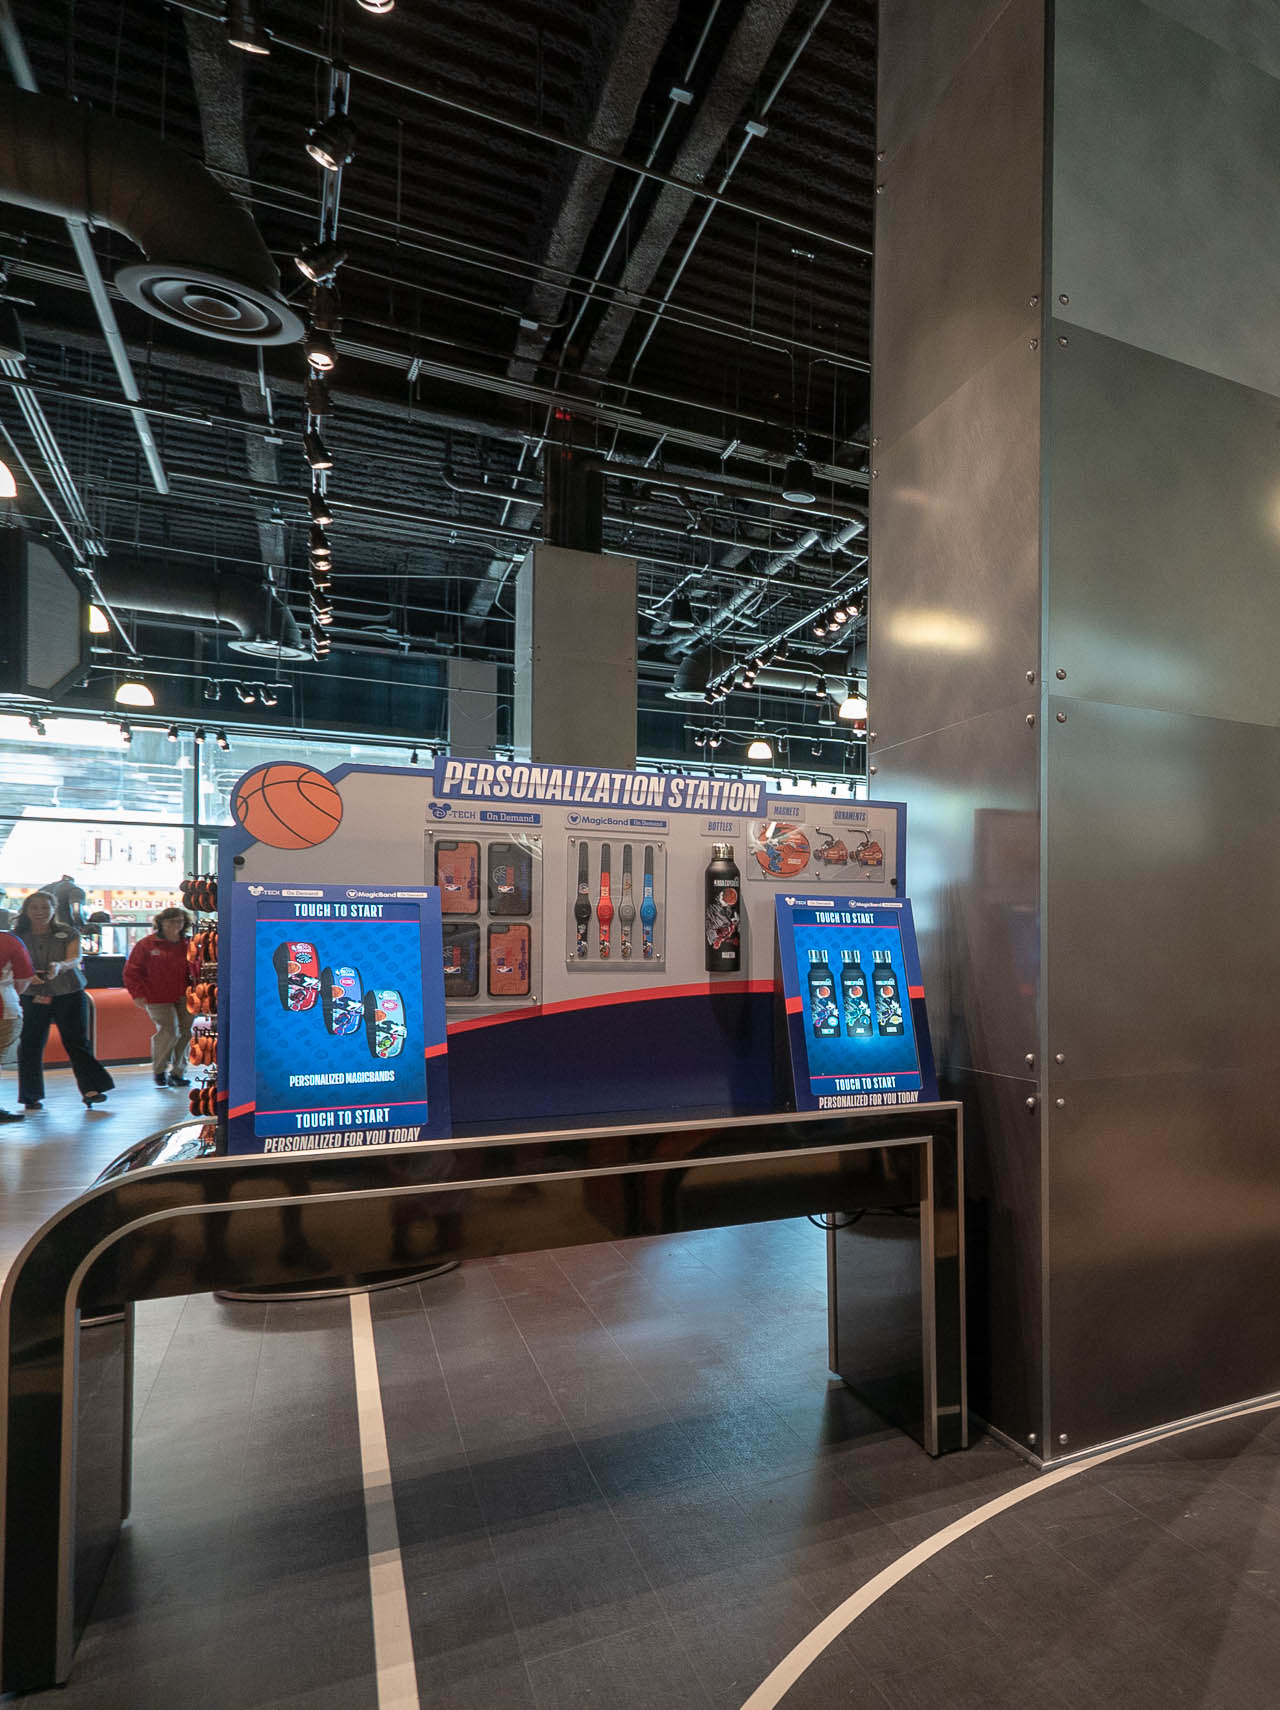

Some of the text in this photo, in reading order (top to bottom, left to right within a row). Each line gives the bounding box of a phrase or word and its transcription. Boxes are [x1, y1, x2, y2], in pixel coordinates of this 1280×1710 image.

[442, 761, 761, 813] PERSONALIZATION STATION
[486, 812, 498, 821] On
[499, 813, 534, 823] Demand
[774, 806, 800, 817] MAGNETS
[581, 816, 629, 827] MagicBand
[708, 821, 733, 832] BOTTLES
[358, 890, 397, 899] MagicBand
[294, 903, 384, 918] TOUCH TO START
[815, 911, 874, 924] TOUCH TO START
[289, 1070, 396, 1087] PERSONALIZED MAGICBANDS
[835, 1076, 896, 1091] TOUCH TO START
[818, 1091, 919, 1109] PERSONALIZED FOR YOU TODAY
[295, 1108, 391, 1129] TOUCH TO START
[264, 1127, 421, 1154] PERSONALIZED FOR YOU TODAY
